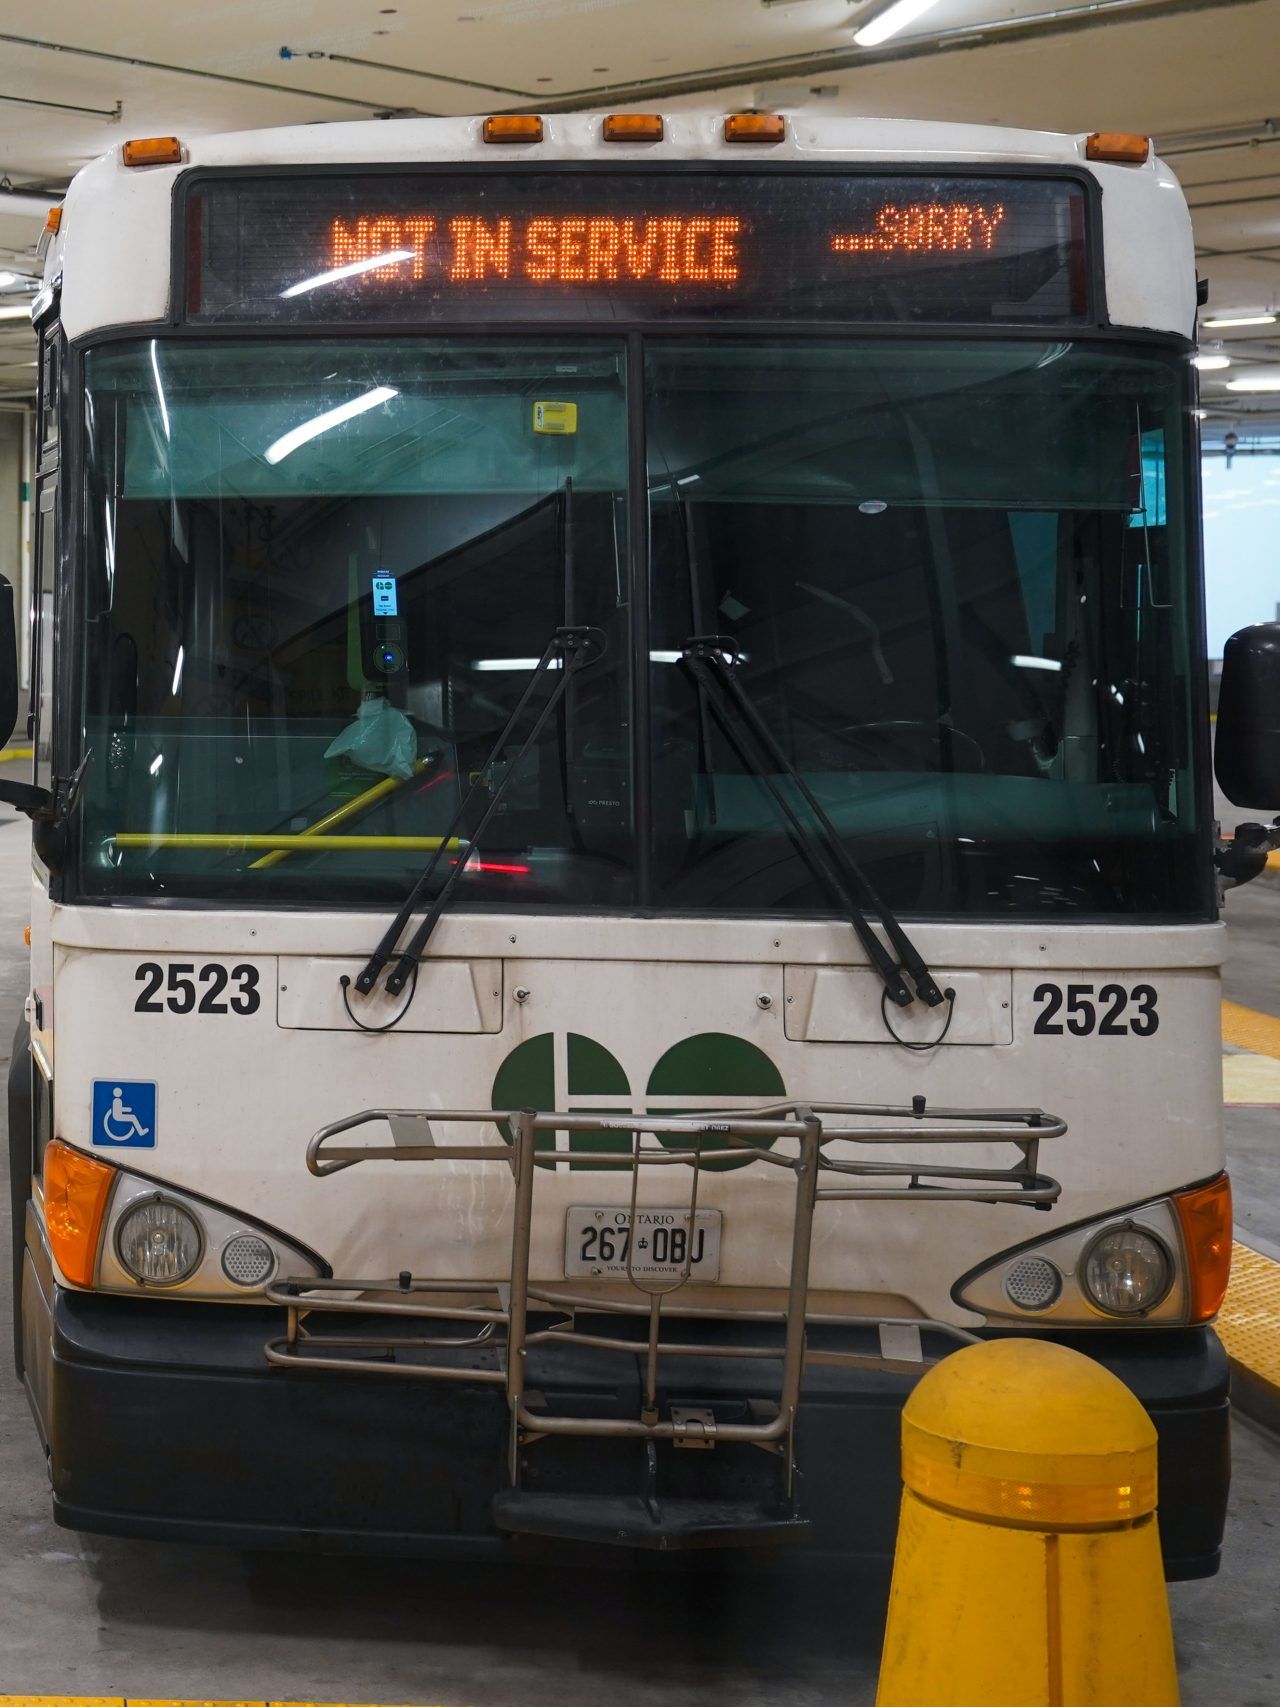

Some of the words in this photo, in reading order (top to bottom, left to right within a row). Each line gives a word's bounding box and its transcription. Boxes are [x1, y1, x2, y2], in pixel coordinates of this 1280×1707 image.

[331, 215, 435, 280] NOT
[450, 215, 511, 280] IN
[525, 215, 740, 280] SERVICE
[134, 962, 261, 1015] 2523
[1032, 983, 1160, 1037] 2523
[581, 1226, 631, 1262] 267
